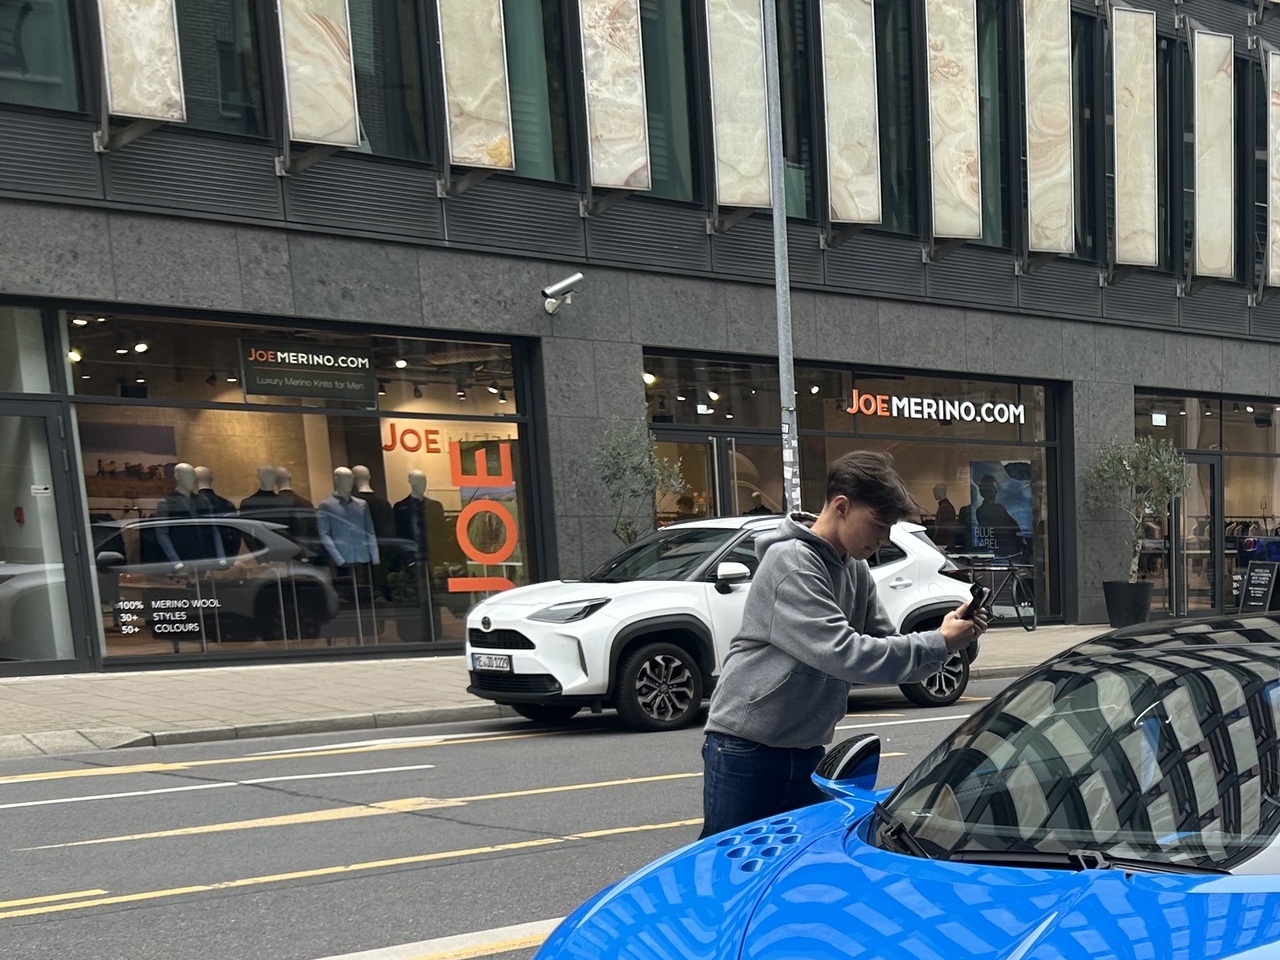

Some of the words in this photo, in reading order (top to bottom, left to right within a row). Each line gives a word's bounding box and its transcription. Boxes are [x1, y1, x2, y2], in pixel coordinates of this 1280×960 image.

[247, 347, 370, 370] JOEMERINO.COM
[256, 376, 283, 387] Luxury
[285, 378, 312, 387] Merino
[313, 379, 334, 389] Knits
[335, 381, 345, 389] for
[347, 381, 365, 390] Men
[846, 388, 1025, 425] JOEMERINO.COM
[382, 423, 442, 454] JOE
[974, 526, 995, 538] BLUE
[974, 538, 1000, 549] LABEL
[119, 600, 144, 610] 100%
[151, 600, 190, 609] MERINO
[191, 599, 222, 608] WOOL
[120, 613, 139, 622] 30+
[153, 611, 187, 621] STYLES
[121, 625, 140, 634] 50+
[154, 622, 200, 633] COLOURS
